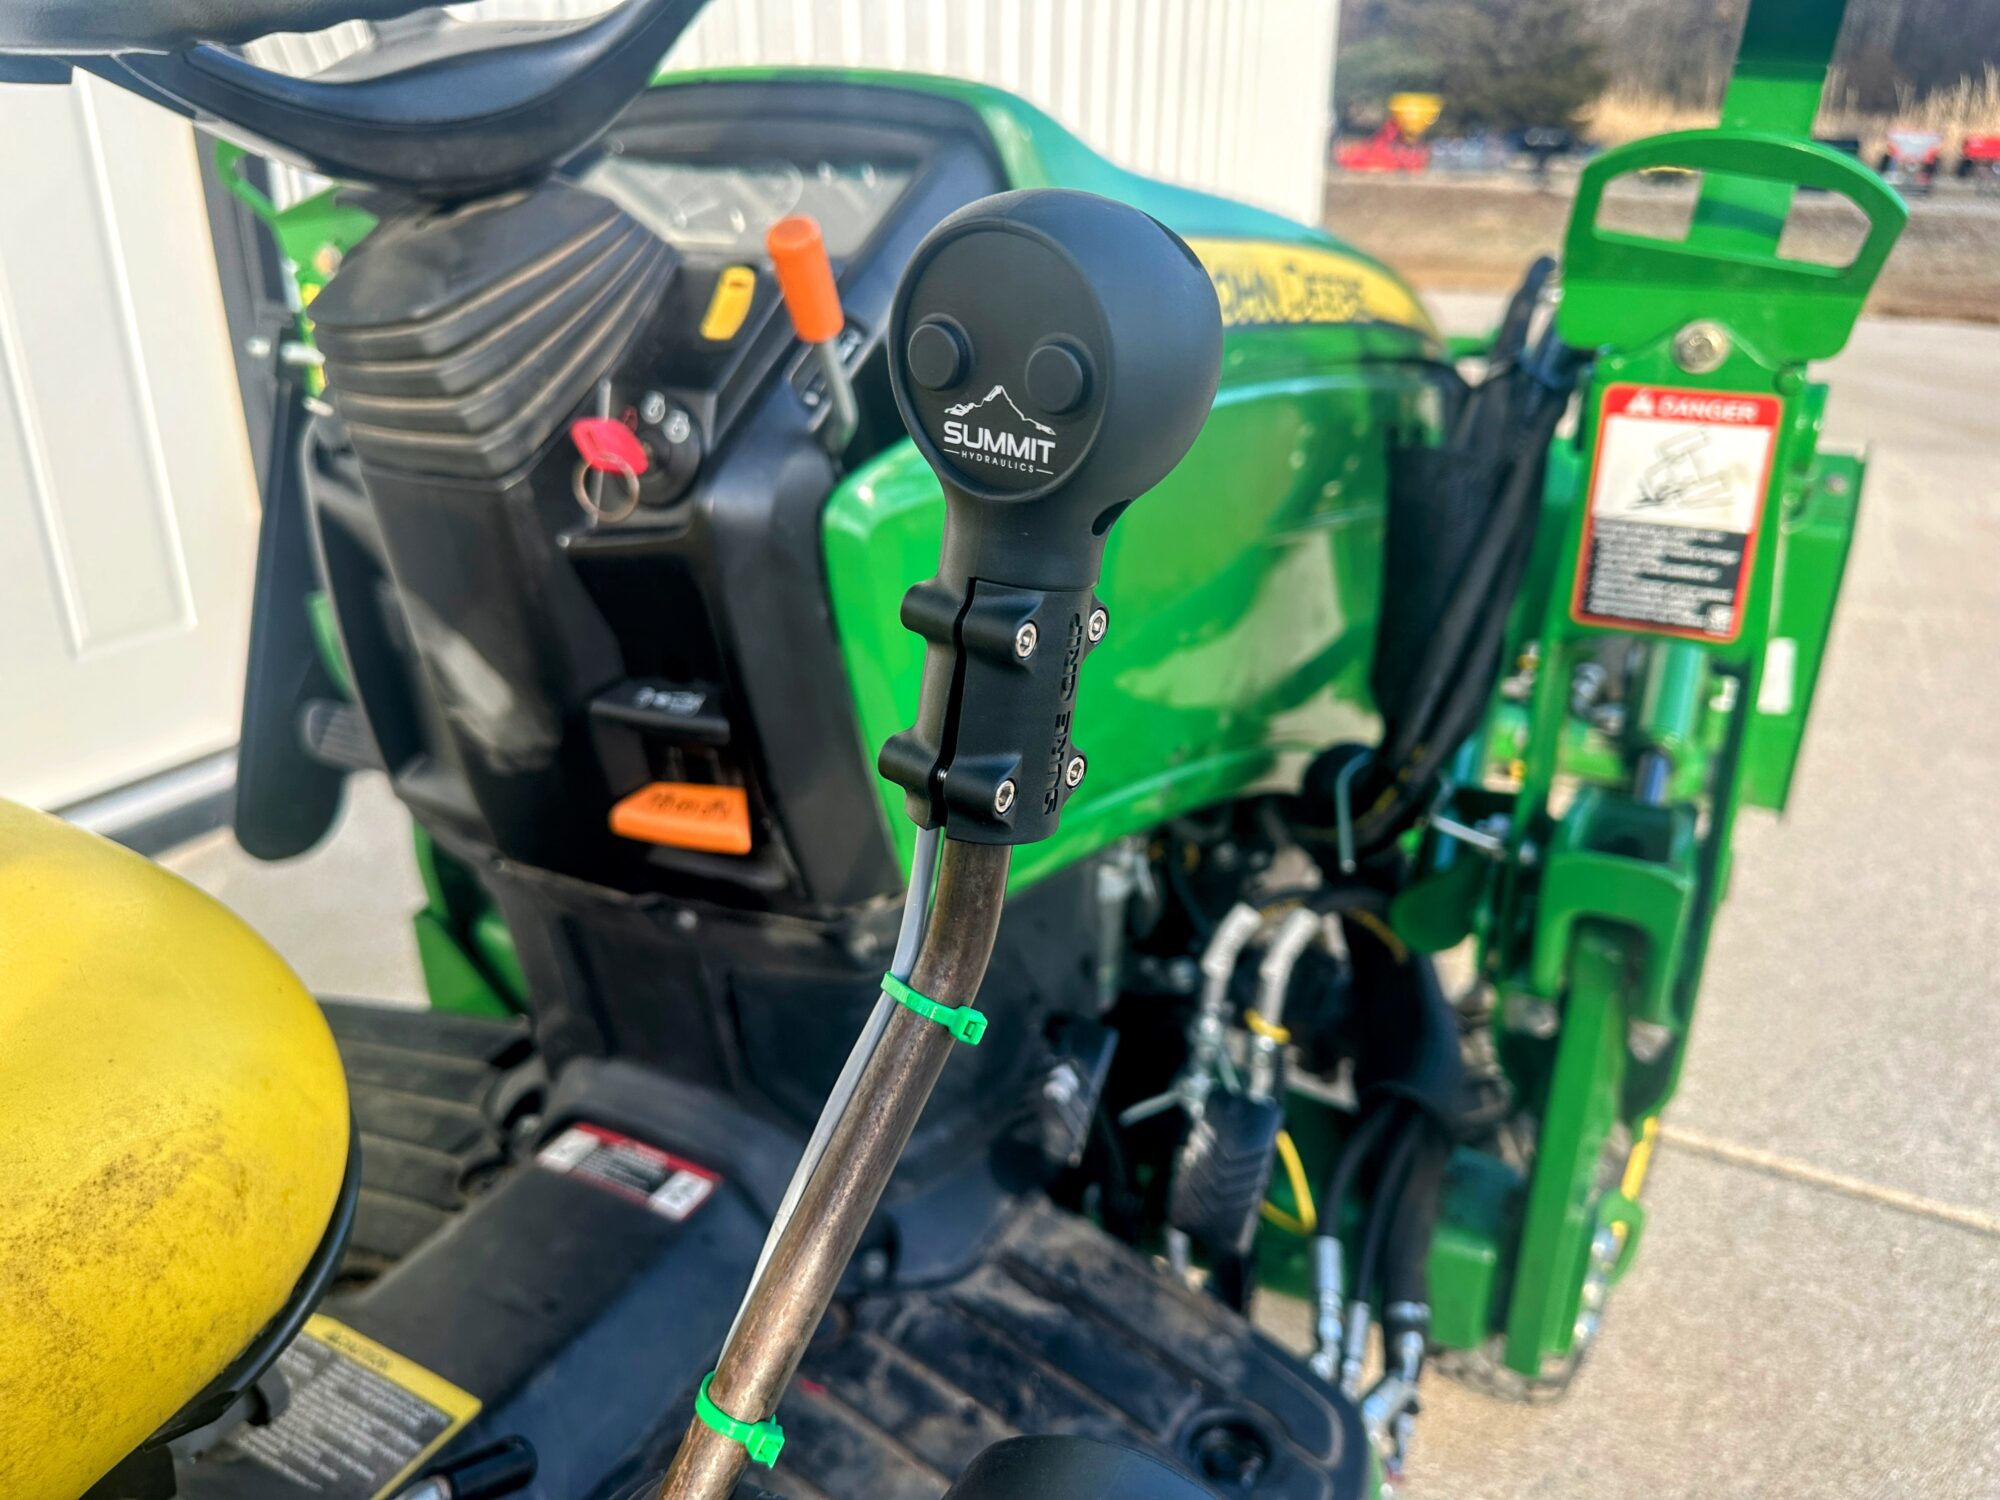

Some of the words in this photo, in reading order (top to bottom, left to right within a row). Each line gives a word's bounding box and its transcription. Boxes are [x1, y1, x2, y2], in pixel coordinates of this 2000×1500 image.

[1658, 394, 1759, 423] DANGER
[943, 420, 1056, 464] SUMMIT
[961, 450, 1035, 474] HYDRAULICS
[1043, 710, 1071, 816] SURE
[1060, 612, 1083, 701] GRIP
